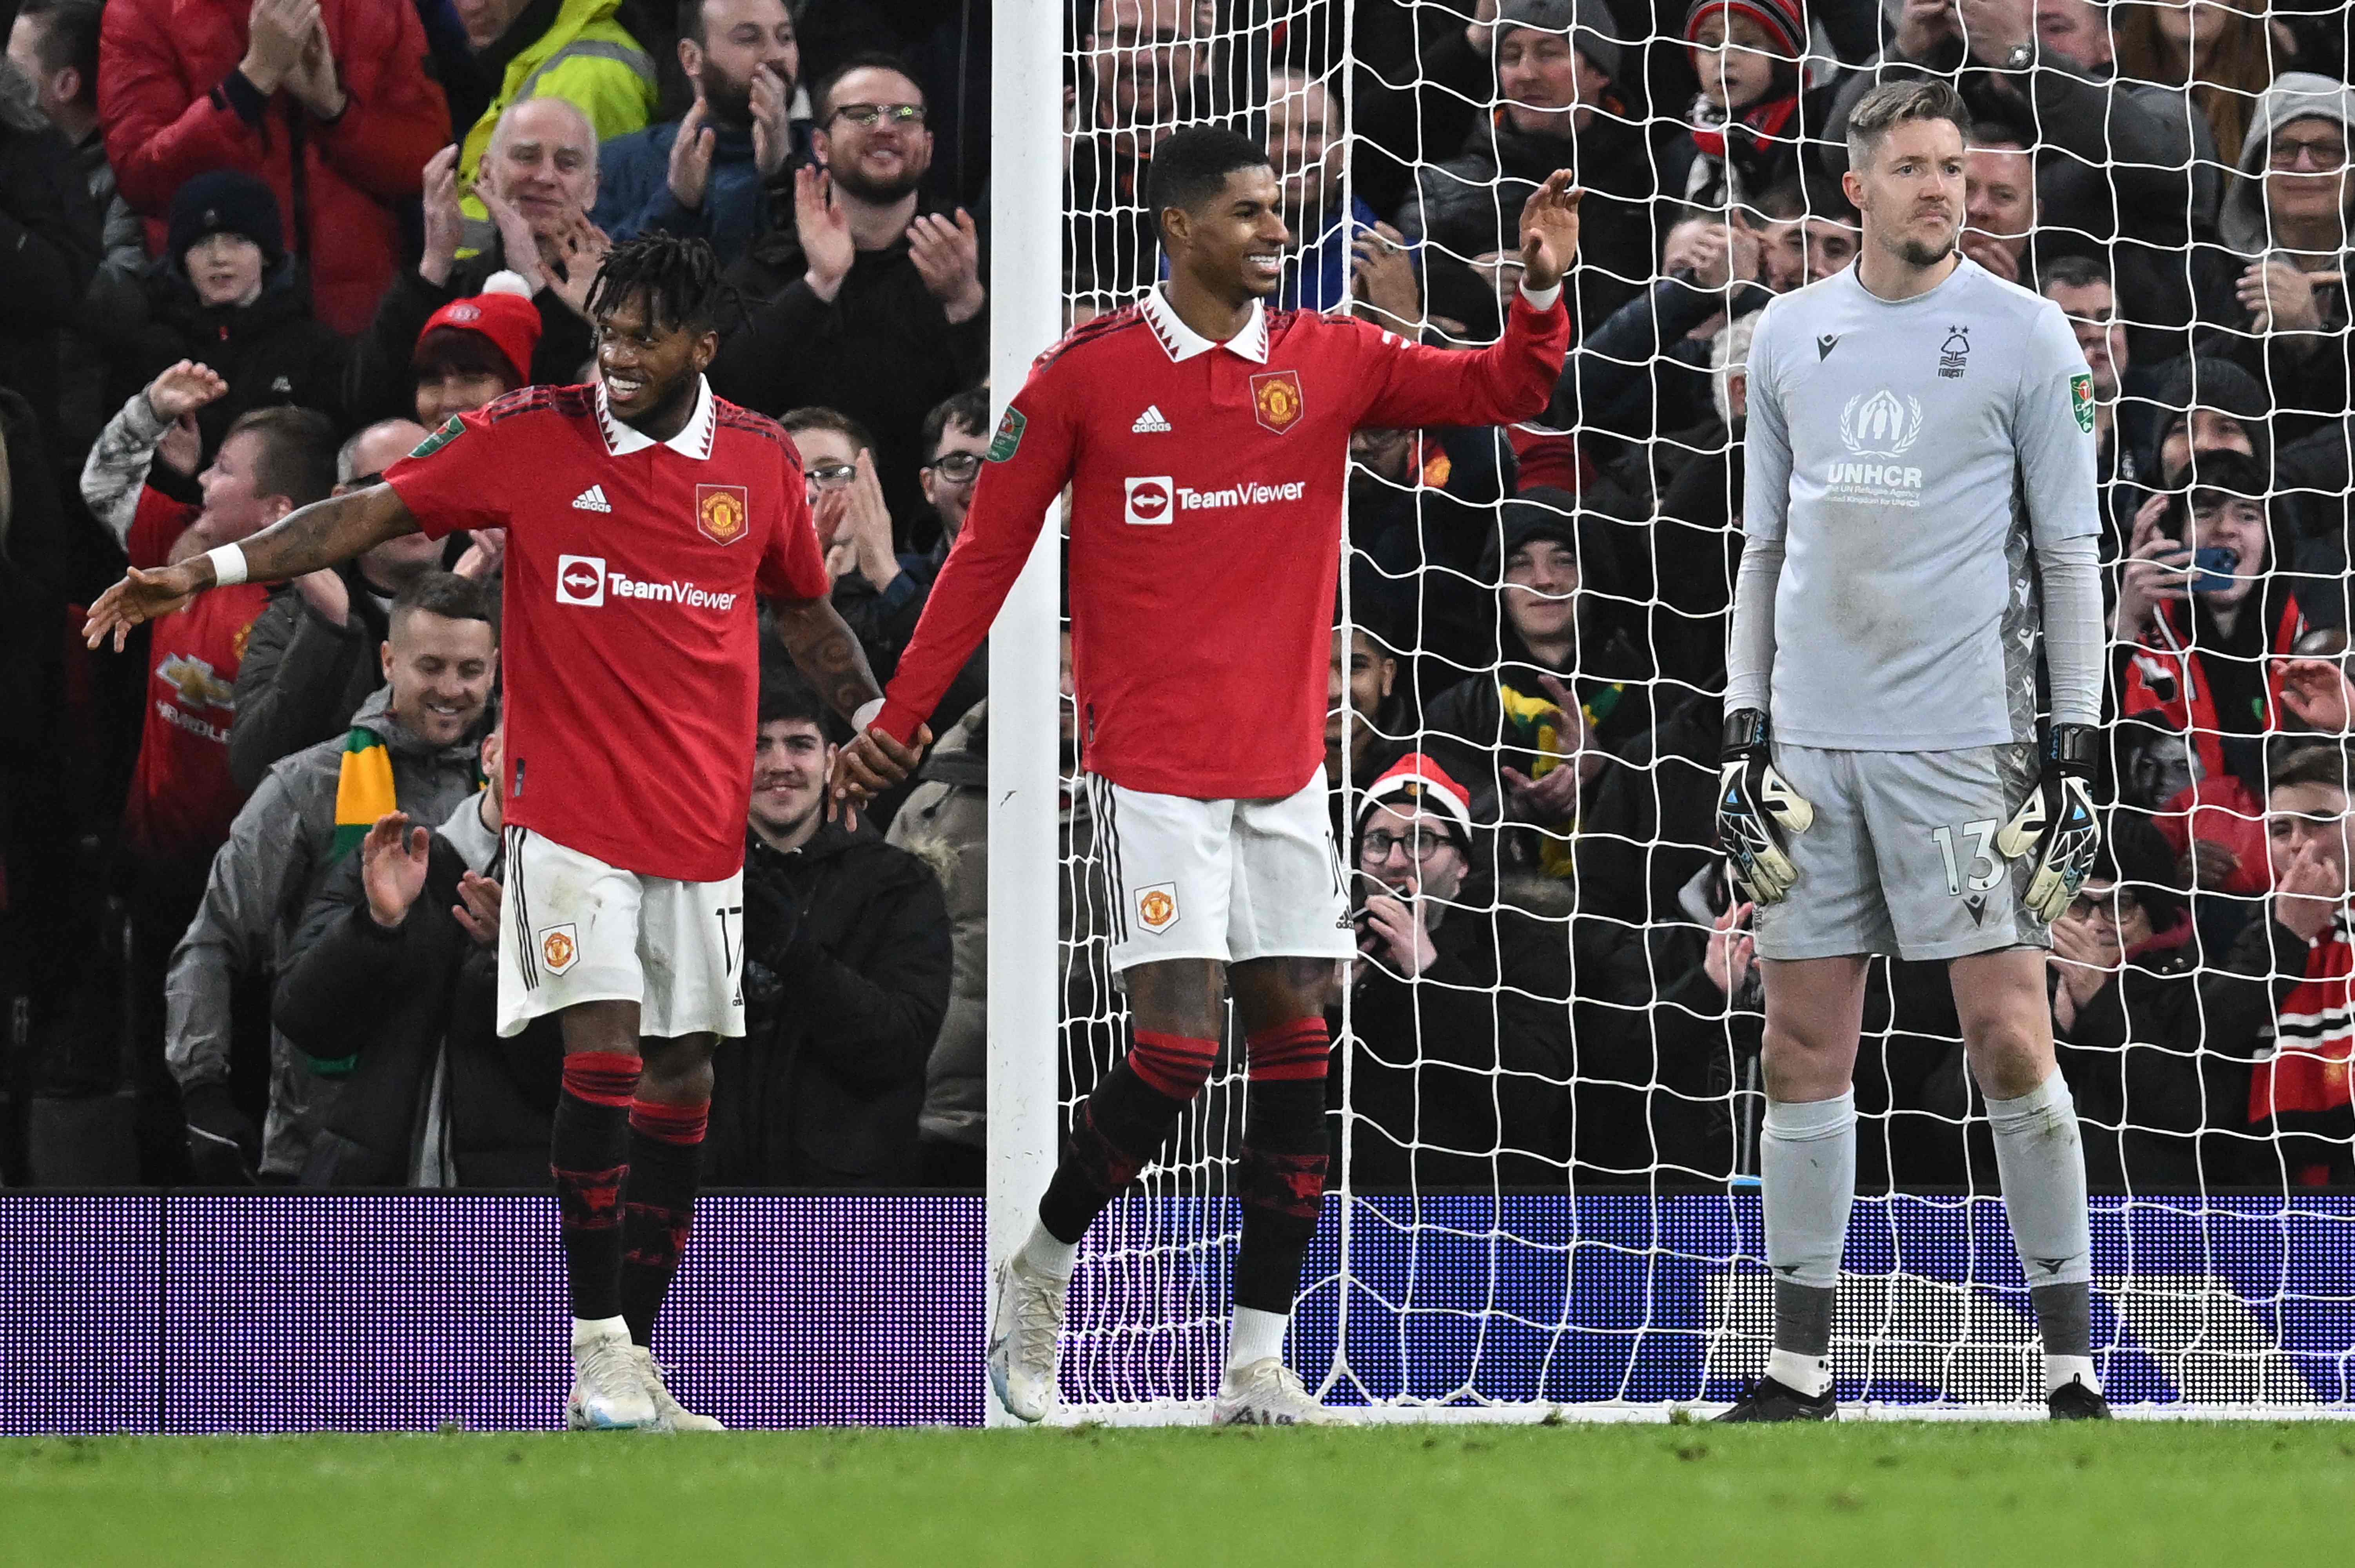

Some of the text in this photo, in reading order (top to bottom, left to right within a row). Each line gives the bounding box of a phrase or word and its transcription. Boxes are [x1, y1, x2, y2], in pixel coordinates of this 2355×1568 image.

[1131, 422, 1172, 433] adidas
[1828, 463, 1922, 488] UNHCR
[572, 499, 612, 513] adidas
[1176, 481, 1306, 510] TeamViewer
[608, 572, 736, 610] TeamViewer
[1932, 818, 2005, 897] 13
